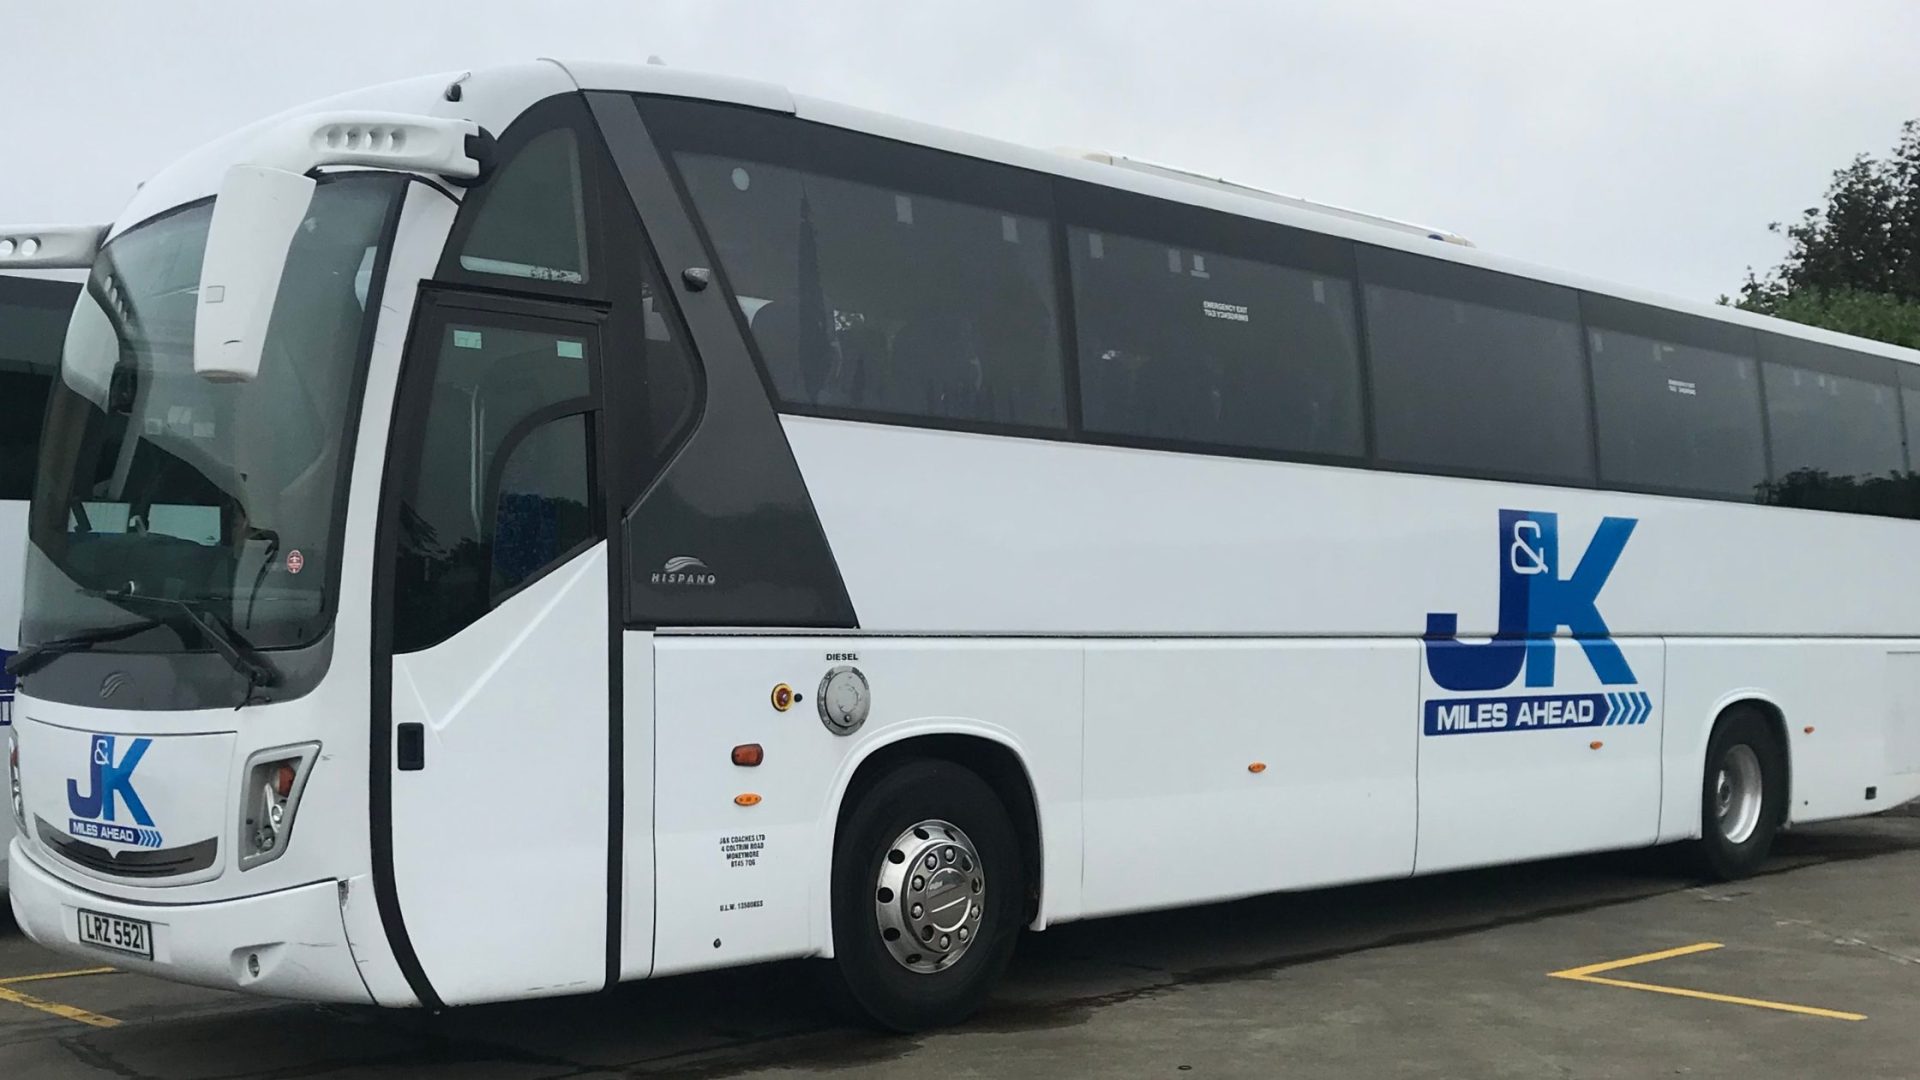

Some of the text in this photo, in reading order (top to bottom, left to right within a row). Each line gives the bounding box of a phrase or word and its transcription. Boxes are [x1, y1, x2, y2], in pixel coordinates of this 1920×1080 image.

[651, 573, 716, 584] HISPANO
[826, 653, 859, 661] DIESEL
[1437, 699, 1595, 731] MILES AHEAD
[72, 821, 134, 842] MILES AHEAD
[730, 834, 755, 844] COACHES
[755, 834, 766, 842] LTD
[749, 842, 764, 850] ROAD
[726, 850, 760, 860] MONEYMORE
[86, 914, 144, 950] LRZ 5521
